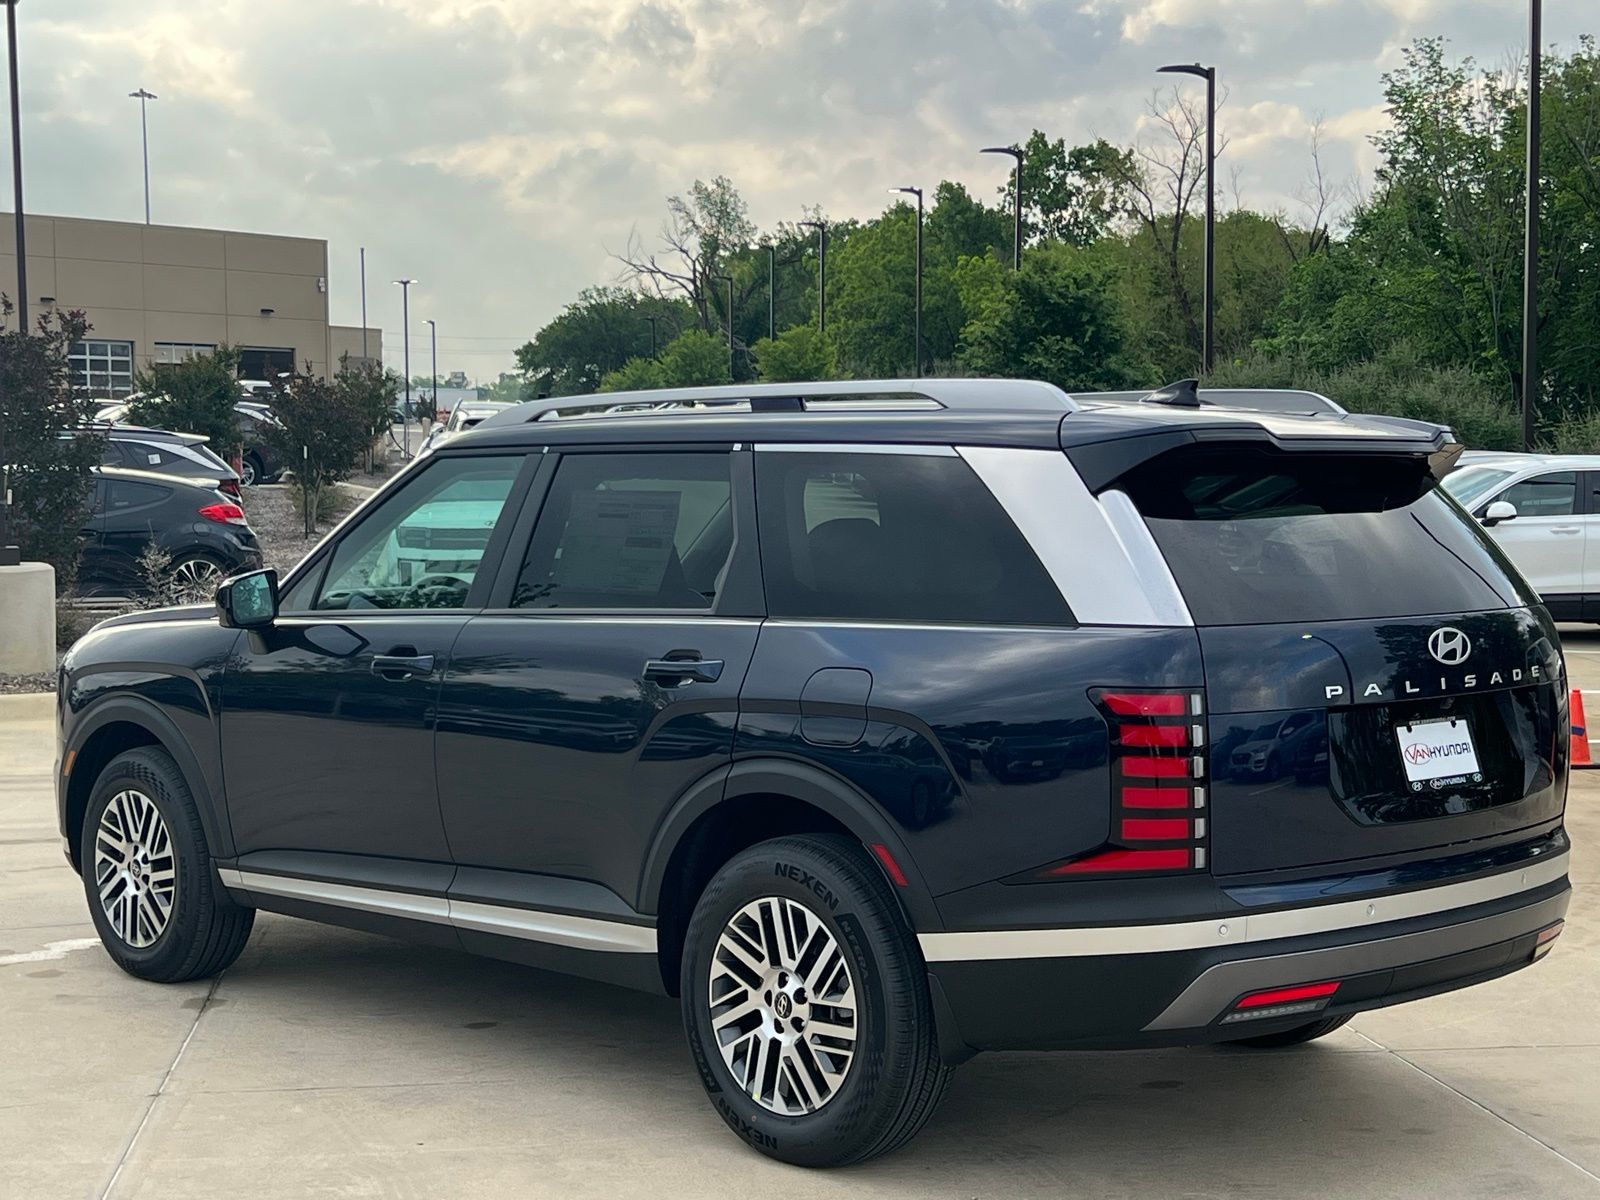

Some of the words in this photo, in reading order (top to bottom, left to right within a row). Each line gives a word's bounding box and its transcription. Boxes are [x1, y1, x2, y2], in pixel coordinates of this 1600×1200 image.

[1325, 665, 1541, 699] PALISADE
[775, 862, 840, 910] NEXEN
[718, 1097, 778, 1149] NEXEN
